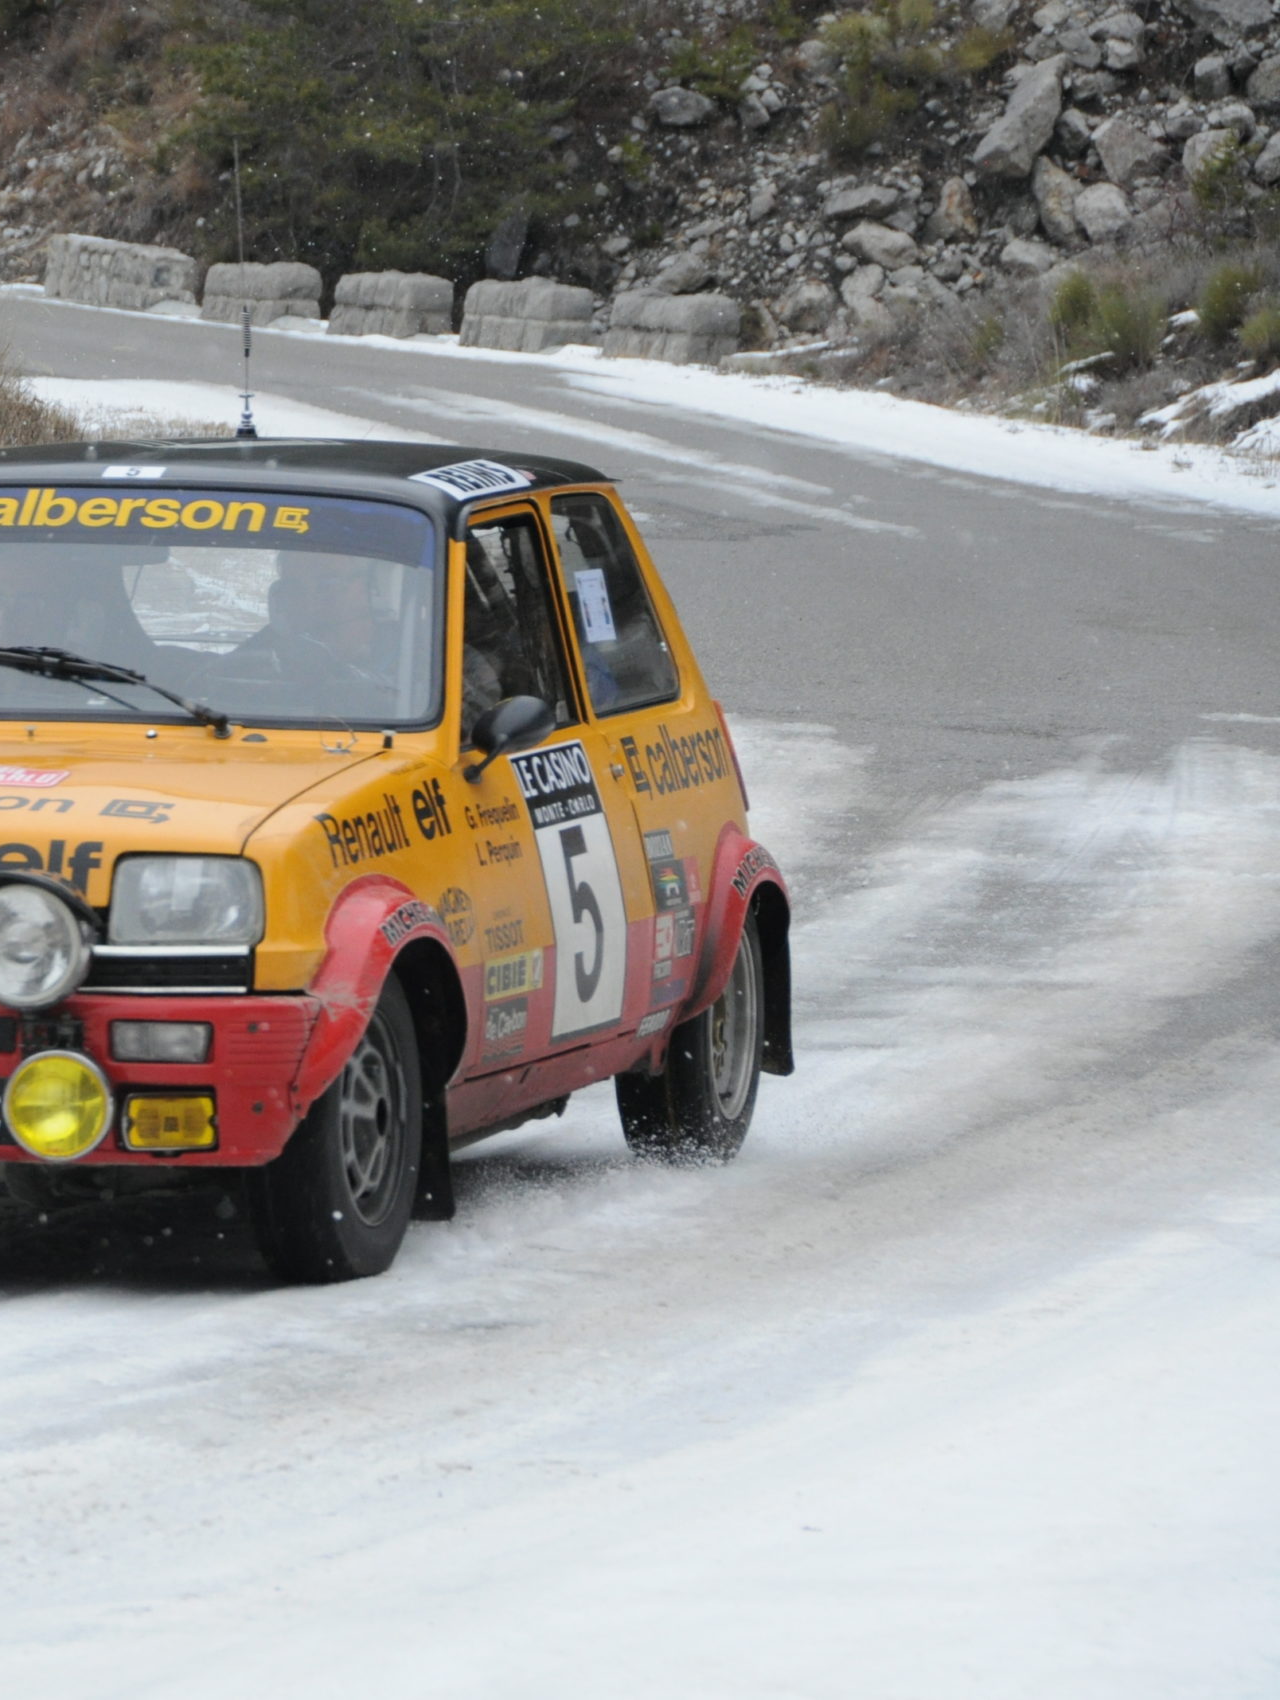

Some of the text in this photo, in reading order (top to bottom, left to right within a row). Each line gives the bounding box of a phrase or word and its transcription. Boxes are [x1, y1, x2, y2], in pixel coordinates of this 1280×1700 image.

[511, 746, 591, 798] LE CASINO
[646, 723, 730, 795] calberson
[313, 777, 452, 869] Renault elf
[485, 919, 524, 953] TISSOT
[560, 824, 604, 1002] 5
